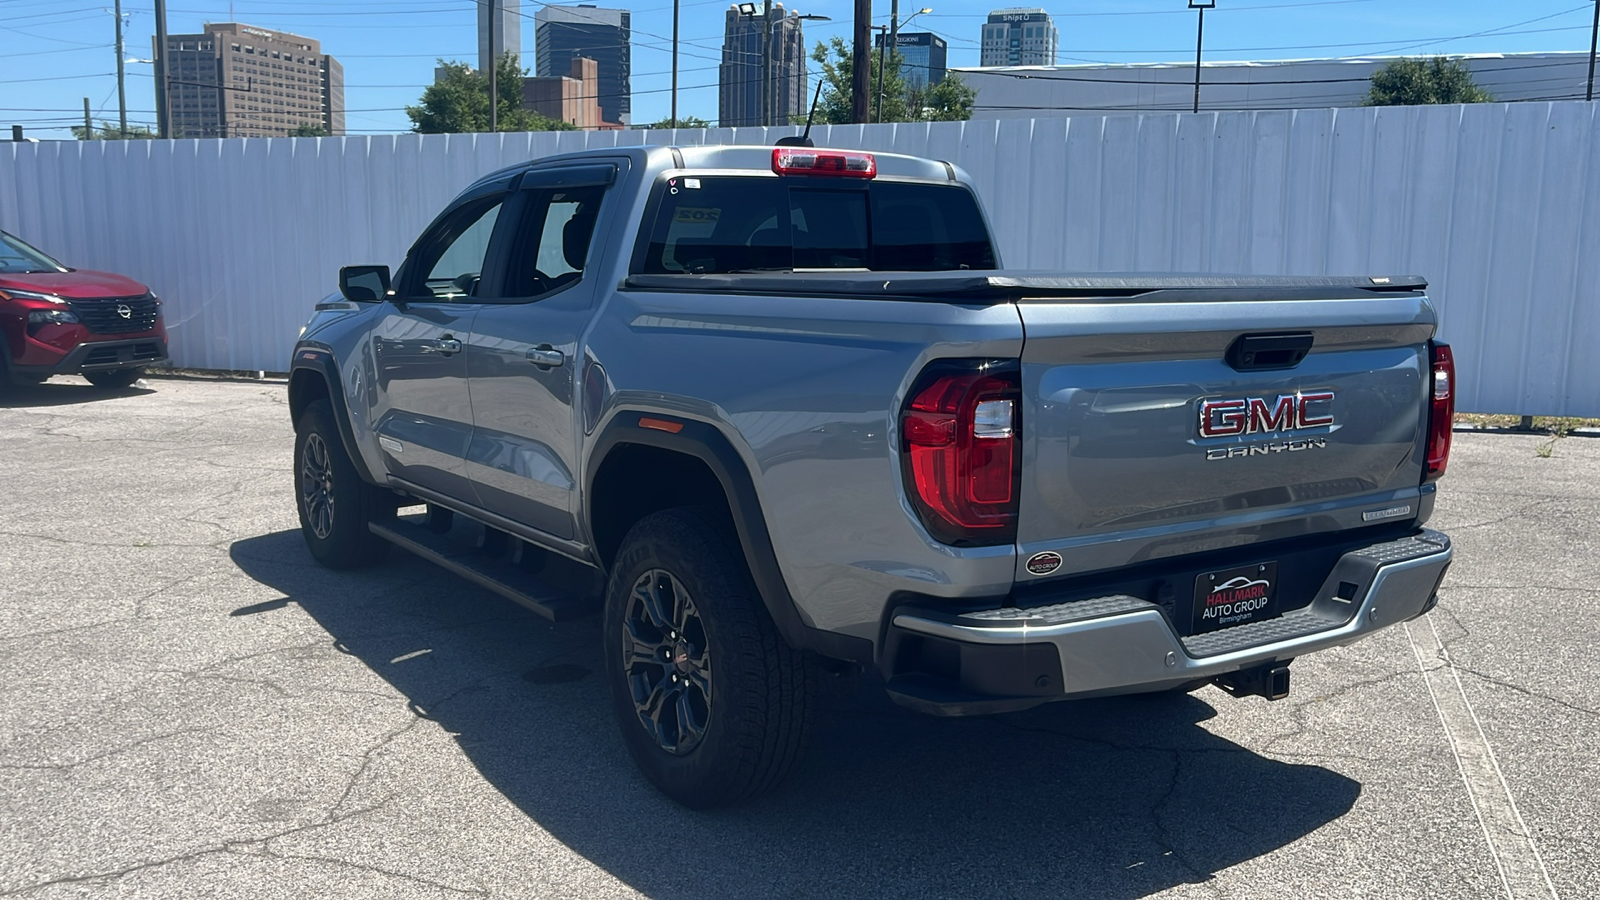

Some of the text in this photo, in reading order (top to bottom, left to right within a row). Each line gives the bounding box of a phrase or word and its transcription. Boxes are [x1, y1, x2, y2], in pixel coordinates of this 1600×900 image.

[1199, 391, 1335, 438] GMC
[1206, 437, 1327, 461] CANYON
[1206, 585, 1265, 606] HALLMARK
[1202, 597, 1268, 619] AUTO GROUP
[1219, 612, 1252, 624] Birmingham
